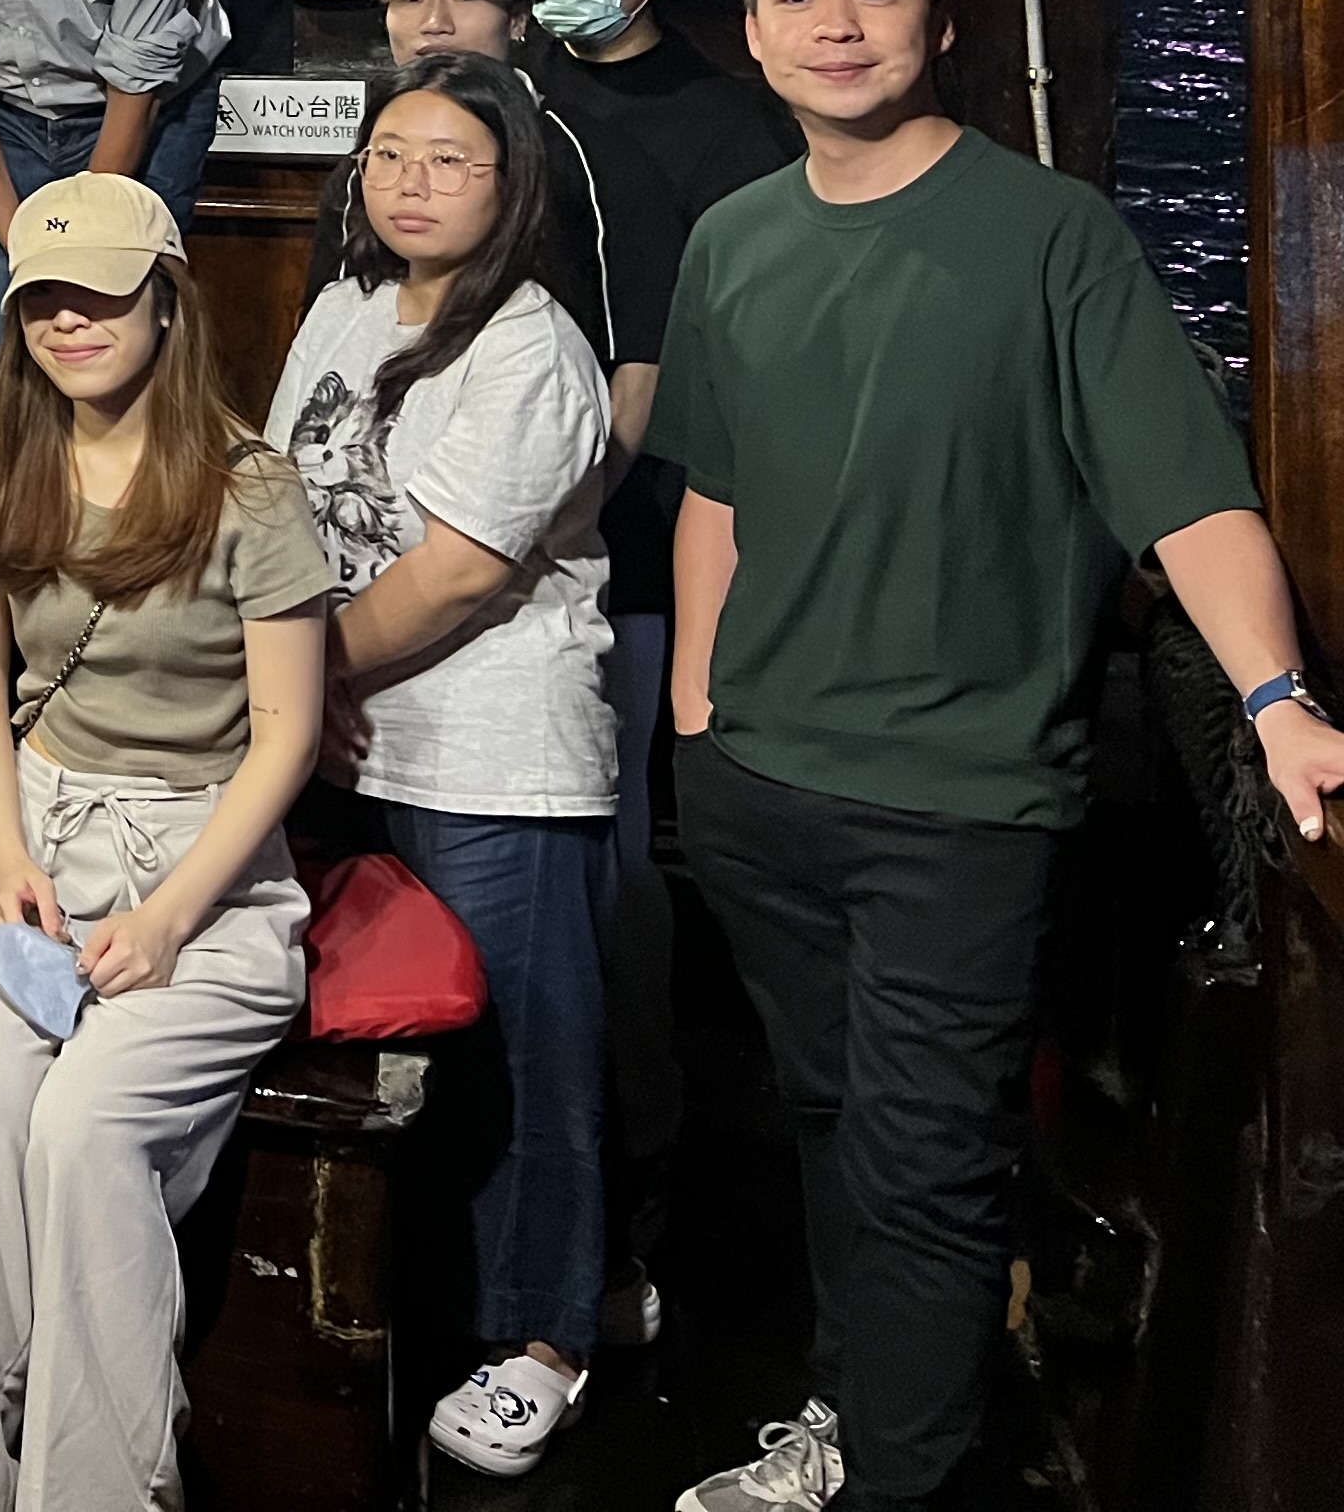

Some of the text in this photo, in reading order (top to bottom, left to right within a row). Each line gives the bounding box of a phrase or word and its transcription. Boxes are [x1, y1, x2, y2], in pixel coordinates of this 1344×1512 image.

[253, 95, 361, 120] 小心台階
[252, 125, 295, 137] WATCH
[298, 125, 330, 138] YOUR
[46, 218, 69, 233] NY
